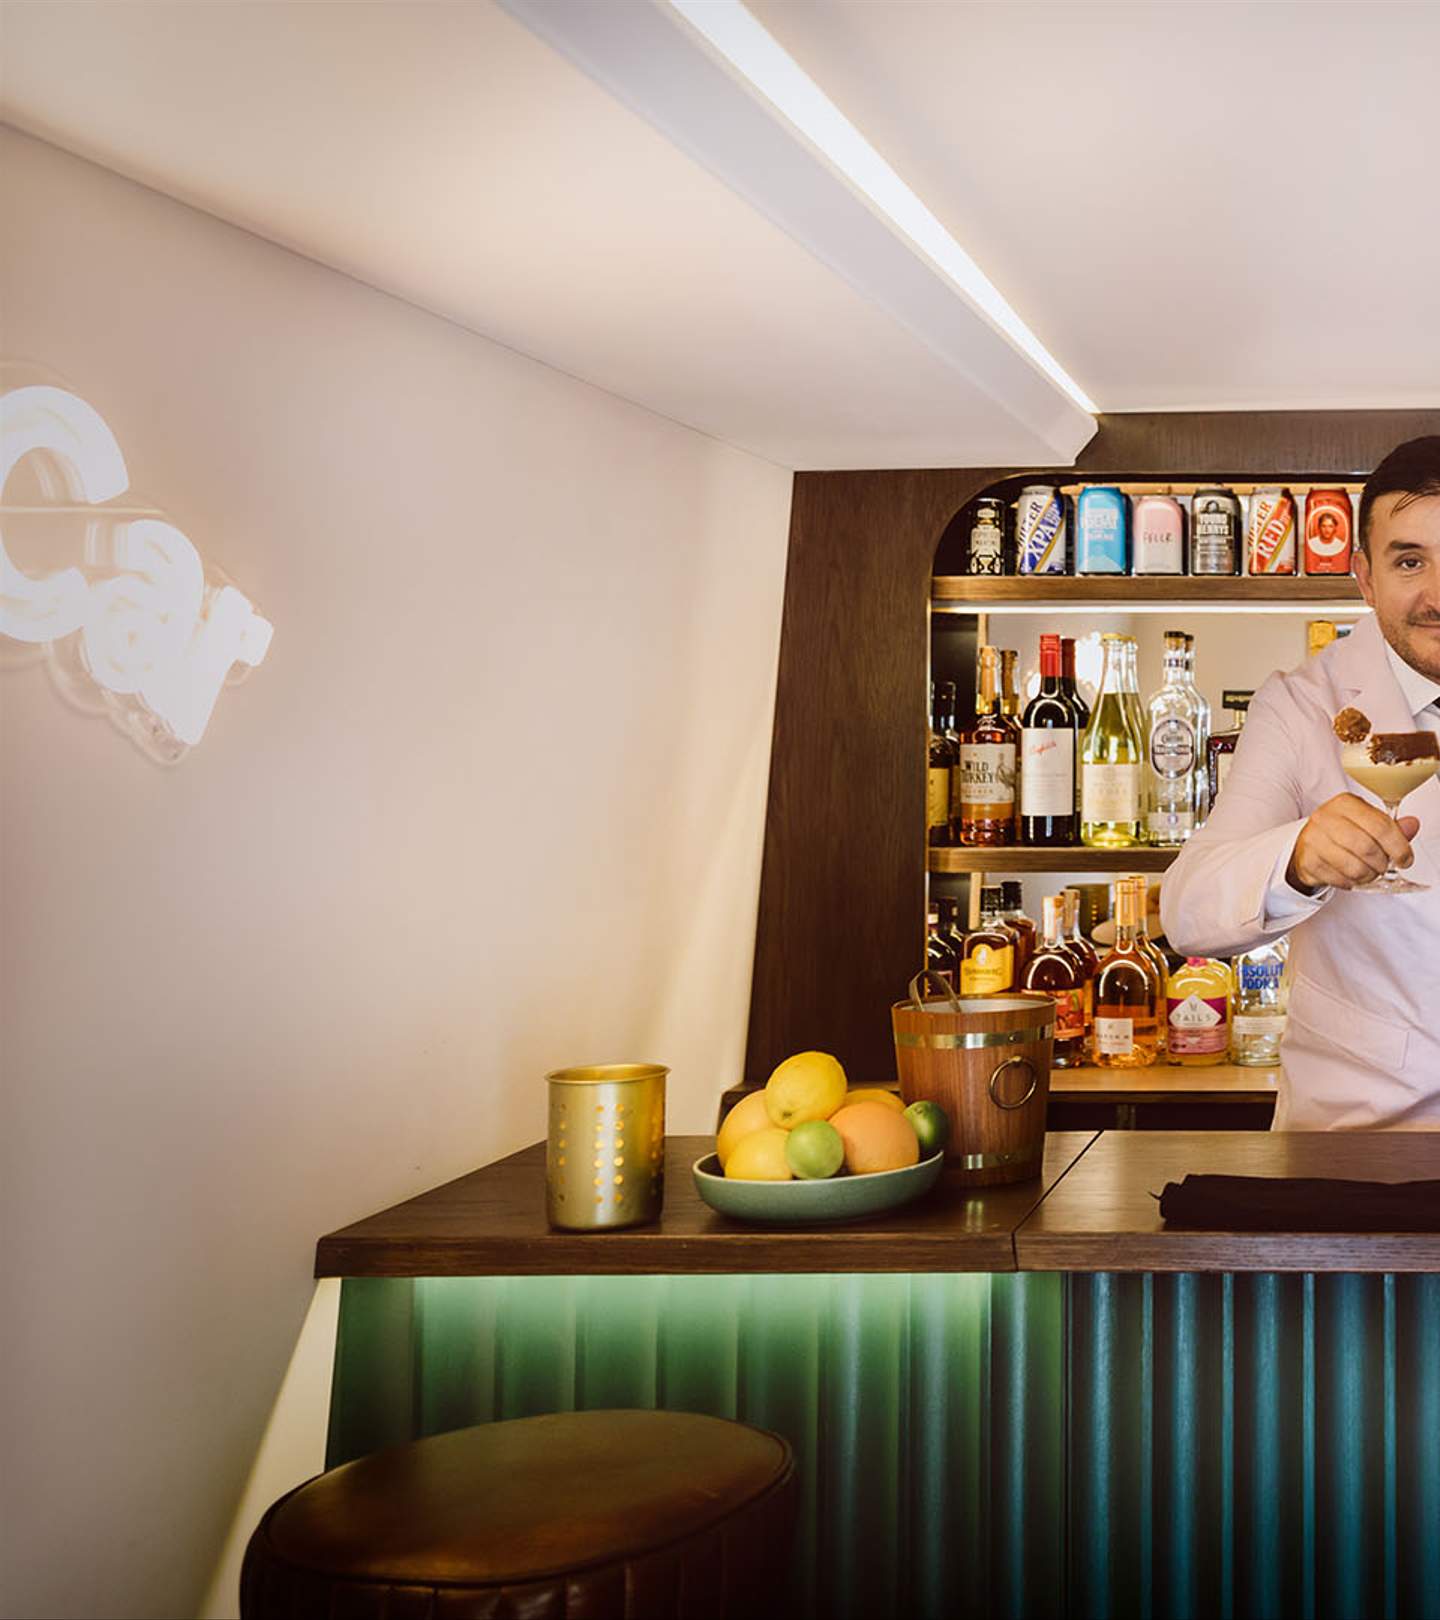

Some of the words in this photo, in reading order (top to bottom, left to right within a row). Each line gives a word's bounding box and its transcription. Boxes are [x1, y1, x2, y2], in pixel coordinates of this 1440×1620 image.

[1027, 518, 1059, 560] XPA
[1257, 519, 1286, 559] RED
[964, 760, 989, 771] WILD
